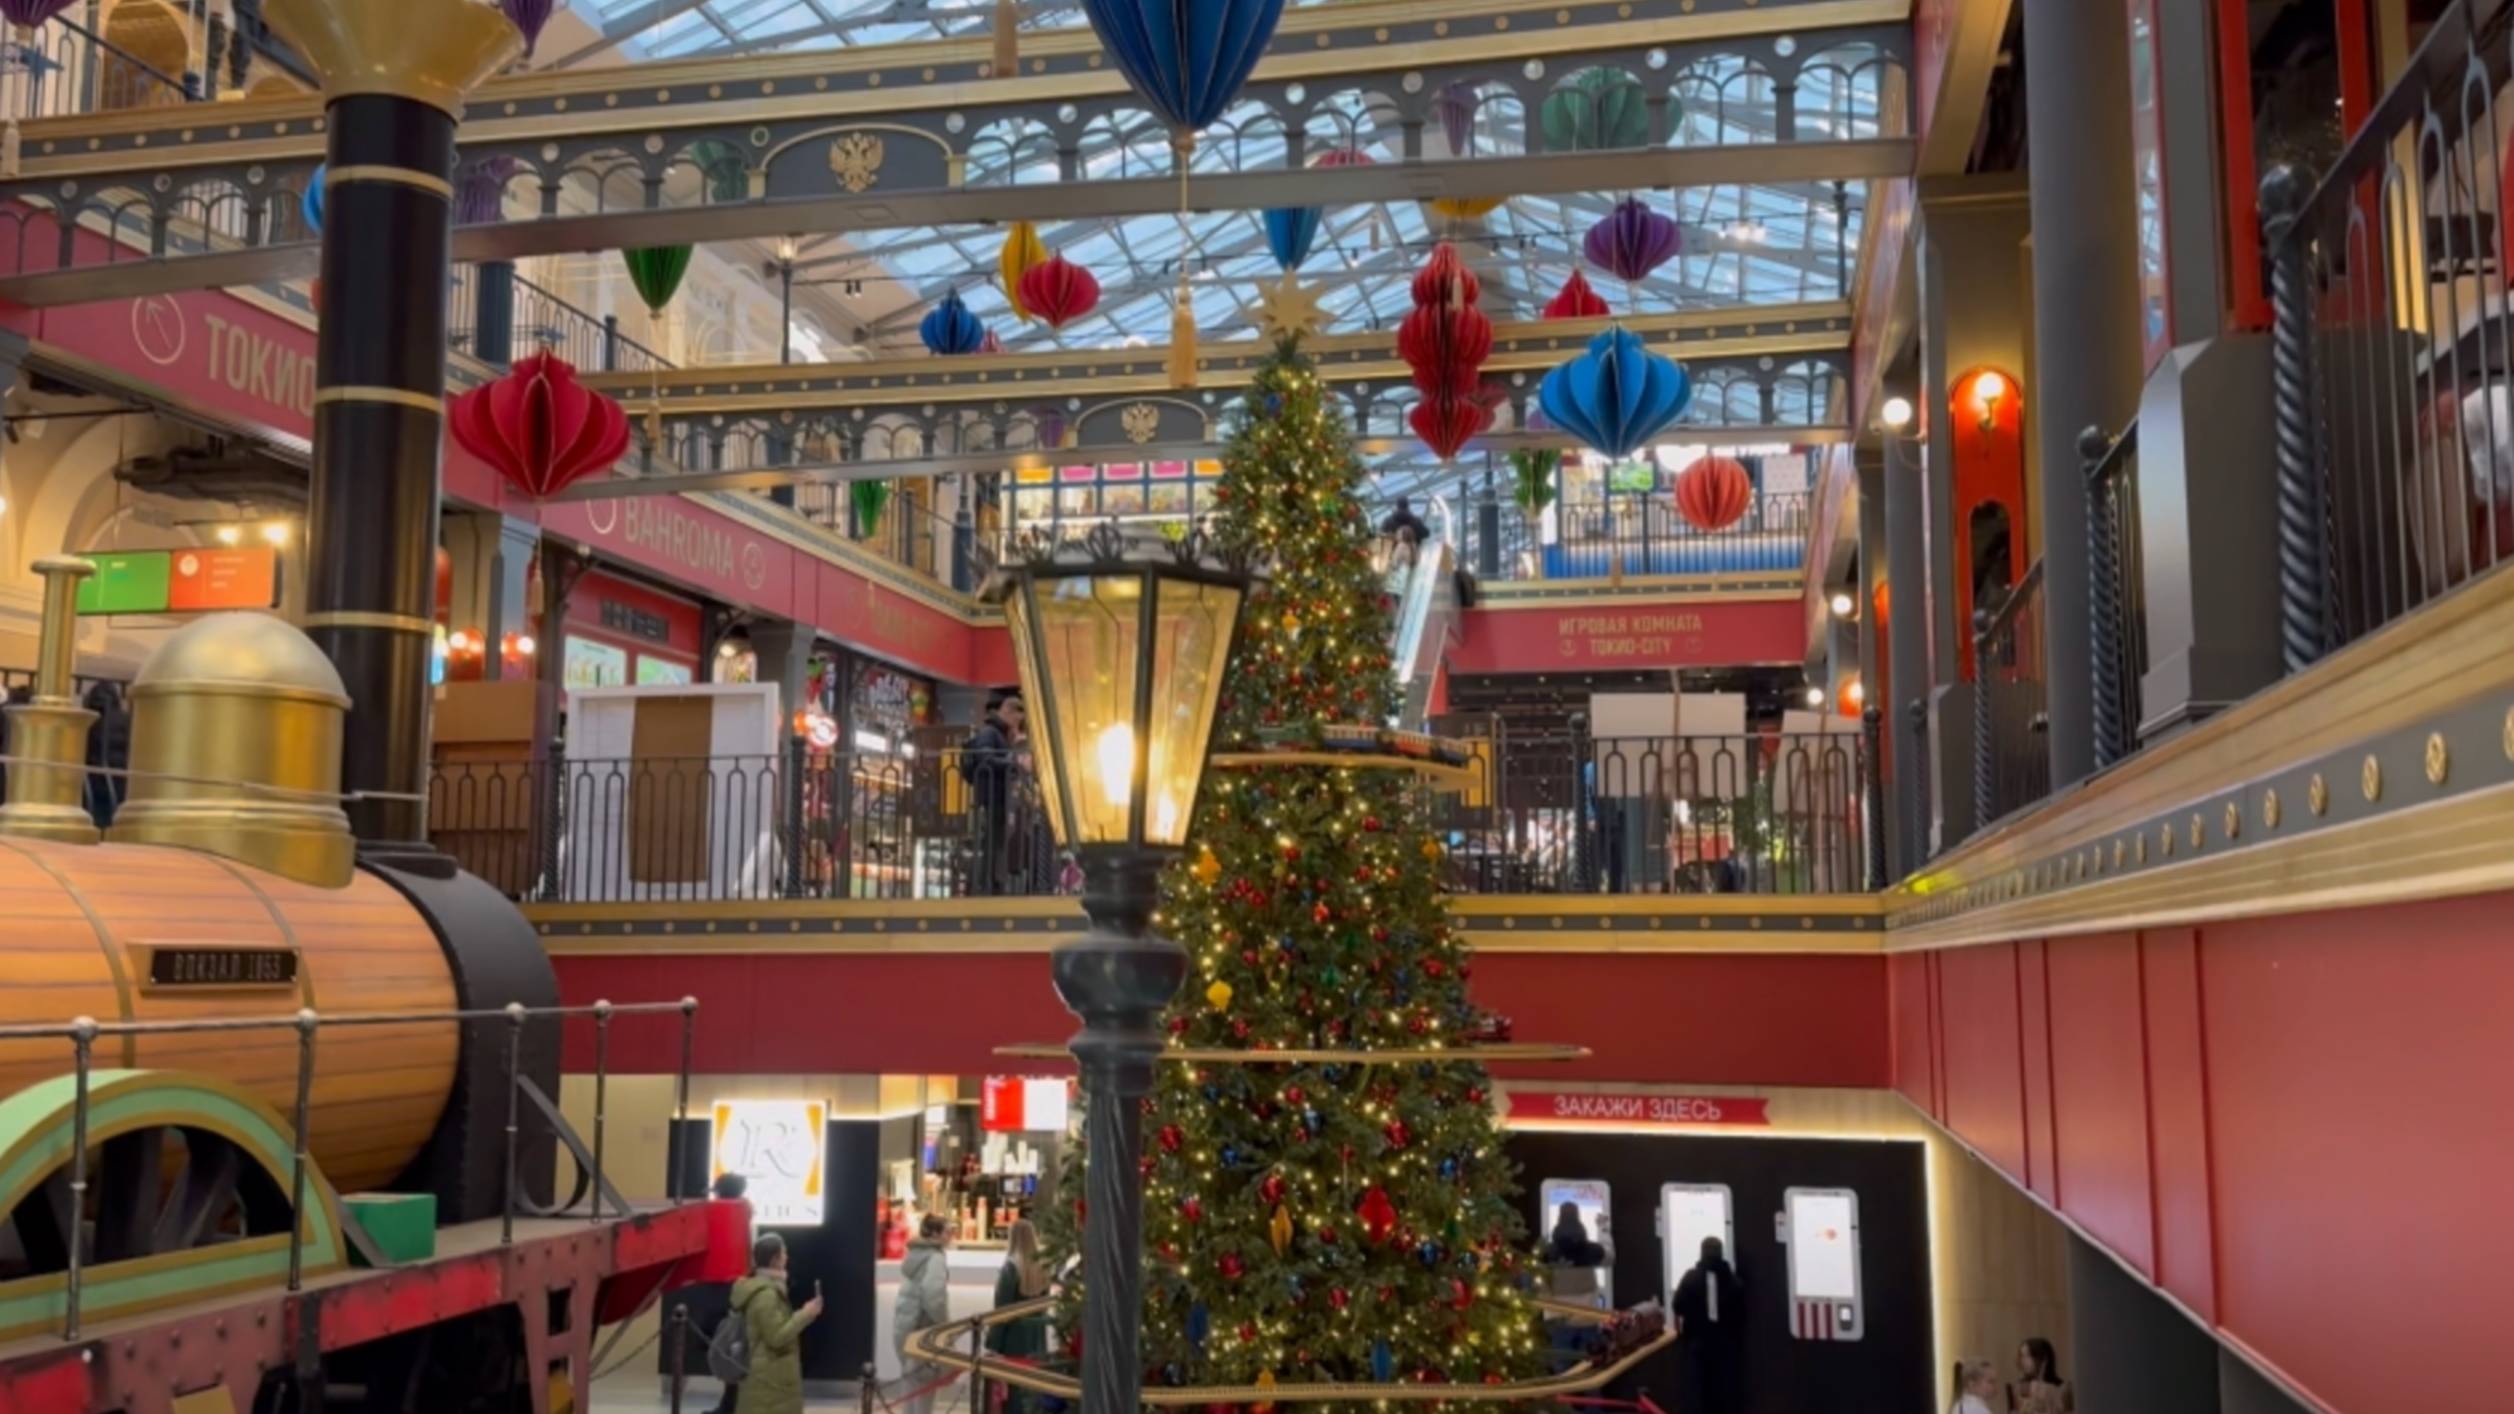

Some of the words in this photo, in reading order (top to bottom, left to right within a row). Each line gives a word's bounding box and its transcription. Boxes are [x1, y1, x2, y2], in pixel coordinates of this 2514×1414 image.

[625, 496, 734, 579] BAHROMA
[1559, 617, 1628, 636] ИГРОВАЯ
[1633, 613, 1702, 632] КОМНАТА
[1554, 1095, 1644, 1118] ЗАКАЖИ
[1650, 1097, 1721, 1121] ЗДЕСЬ
